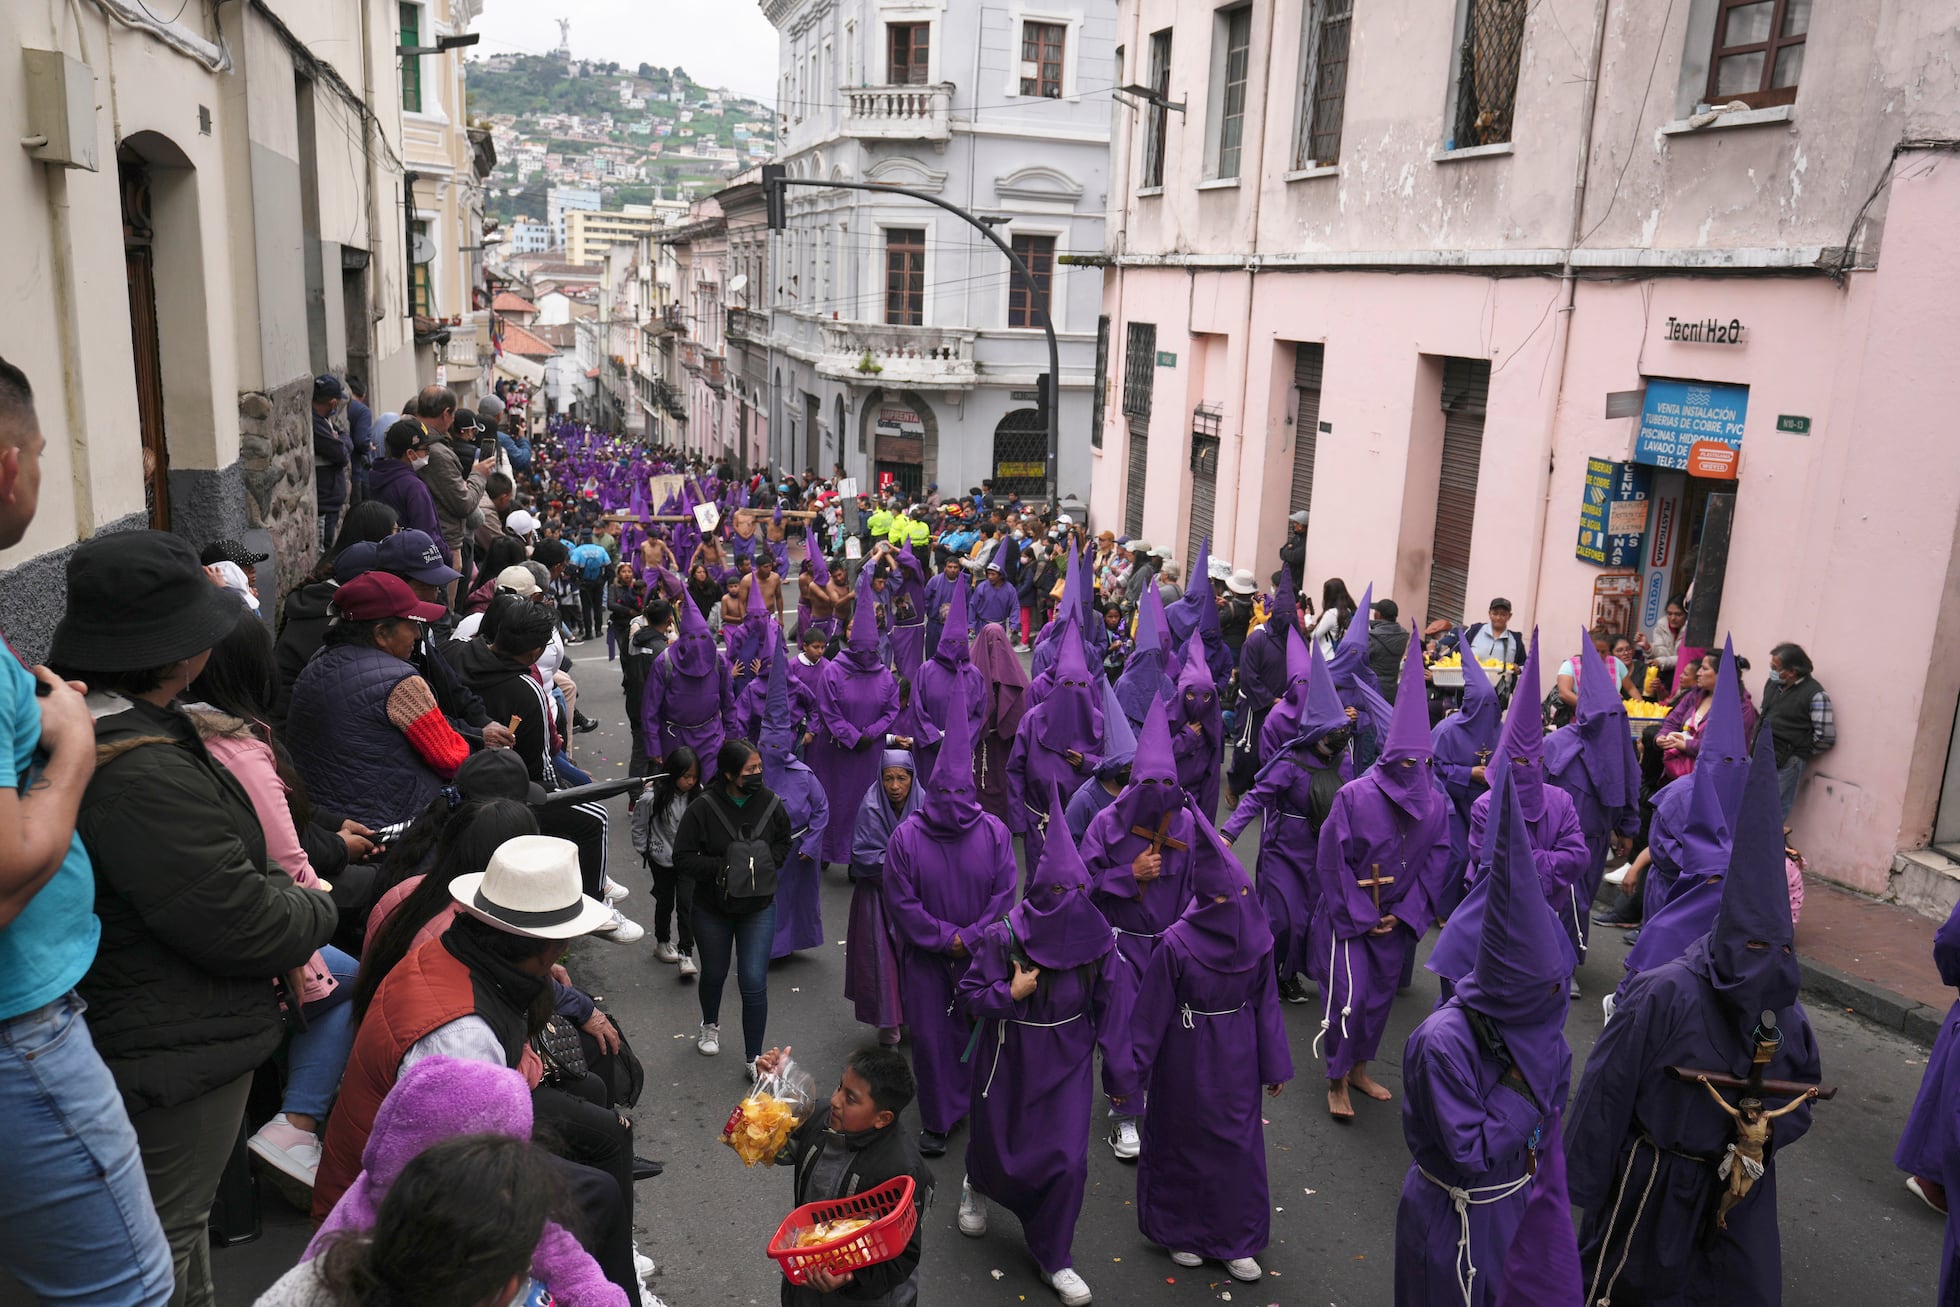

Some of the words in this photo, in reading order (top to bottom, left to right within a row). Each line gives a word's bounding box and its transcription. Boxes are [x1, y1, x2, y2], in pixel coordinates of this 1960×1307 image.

[882, 409, 919, 423] IMPRENTA
[1657, 403, 1680, 415] VENTA
[1682, 405, 1736, 421] INSTALACIÓN
[1646, 413, 1678, 428] TUBERIAS
[1680, 418, 1690, 429] DE
[1692, 419, 1722, 434] COBRE,
[1726, 423, 1744, 435] PVC
[1643, 440, 1675, 454] LAVADO
[1676, 445, 1688, 456] DE
[1588, 460, 1612, 475] TUBERIAS
[1656, 455, 1675, 468] TELF:
[1586, 474, 1593, 485] DE
[1593, 476, 1611, 489] COBRE
[1582, 503, 1602, 517] BOMBAS
[1580, 517, 1587, 527] DE
[1587, 519, 1601, 531] AGUA
[1657, 501, 1671, 561] PLASTIGAMA
[1577, 545, 1605, 562] CALEFONES
[1648, 578, 1660, 621] wavin
